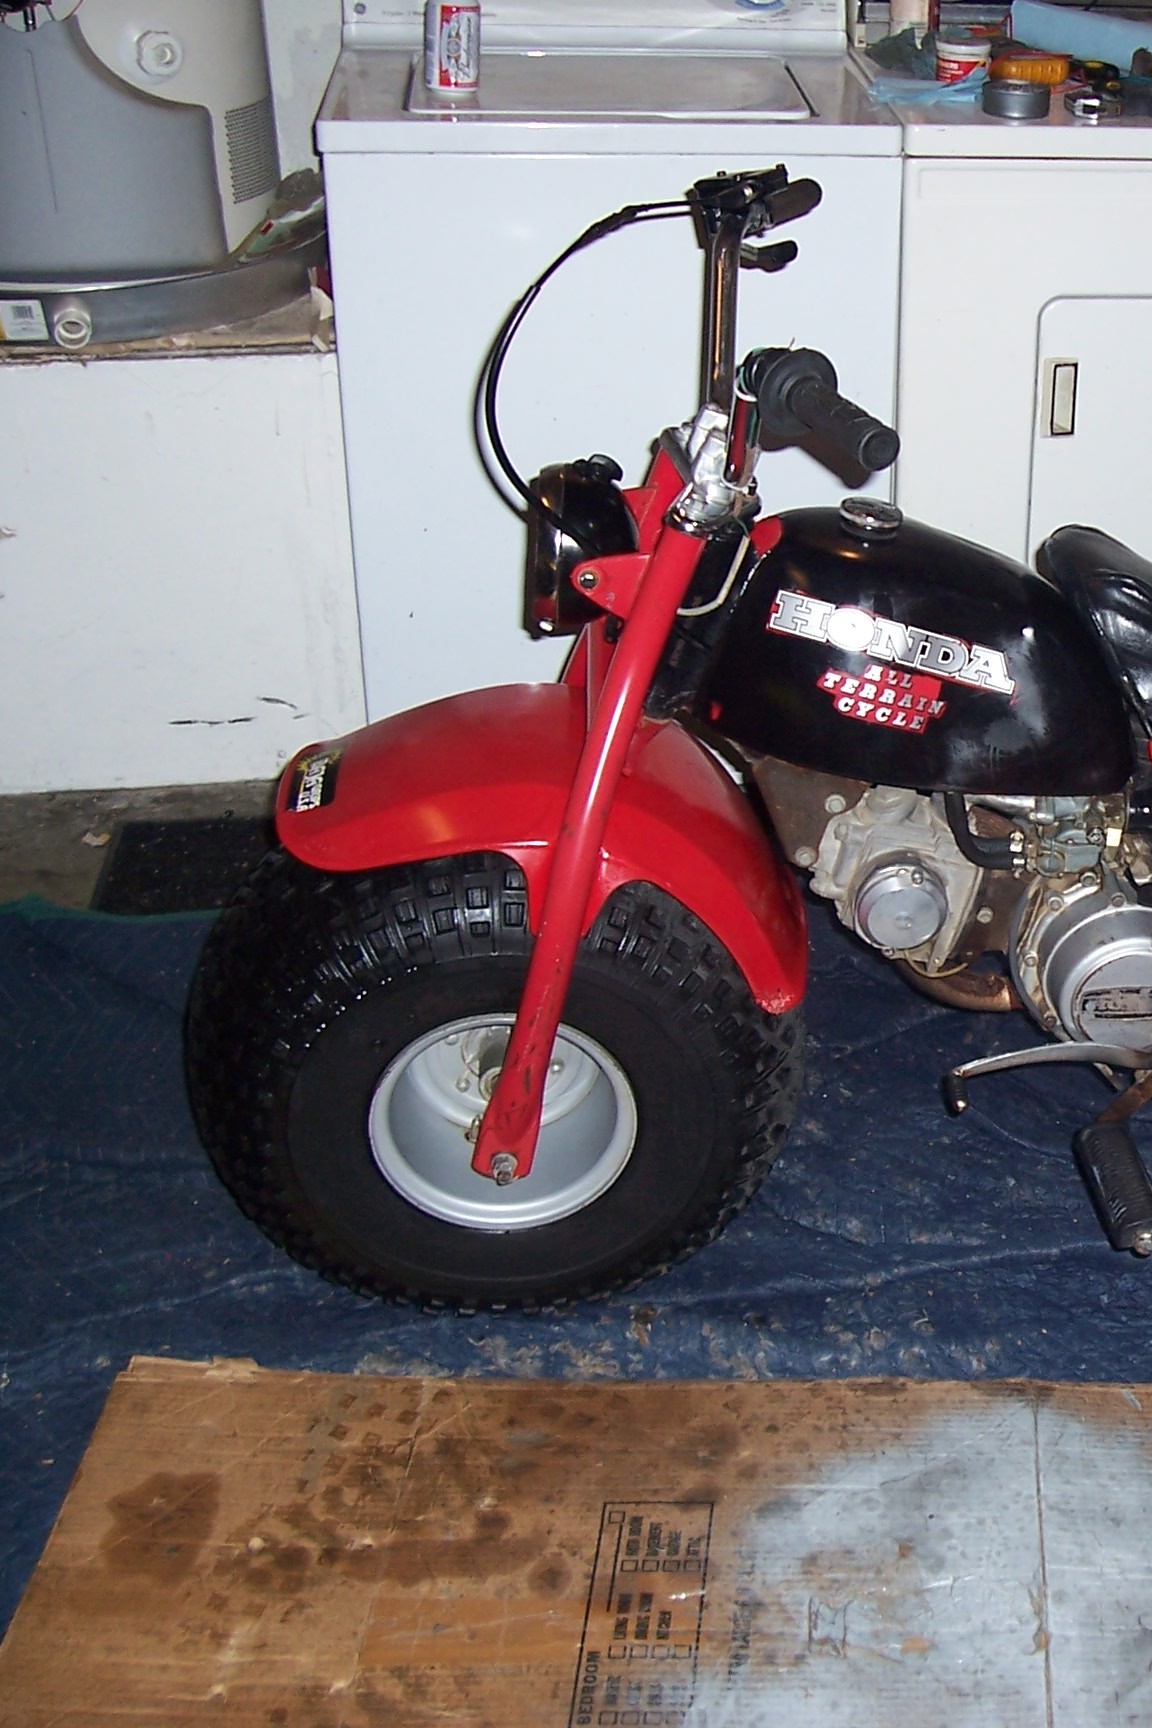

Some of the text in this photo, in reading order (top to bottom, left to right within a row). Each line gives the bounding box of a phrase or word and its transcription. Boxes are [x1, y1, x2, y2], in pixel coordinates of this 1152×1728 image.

[769, 589, 1015, 695] HONDA
[822, 672, 945, 716] TERRAIN
[864, 664, 912, 689] ALL
[837, 697, 926, 731] CYCLE
[577, 1651, 600, 1726] BEDROOM
